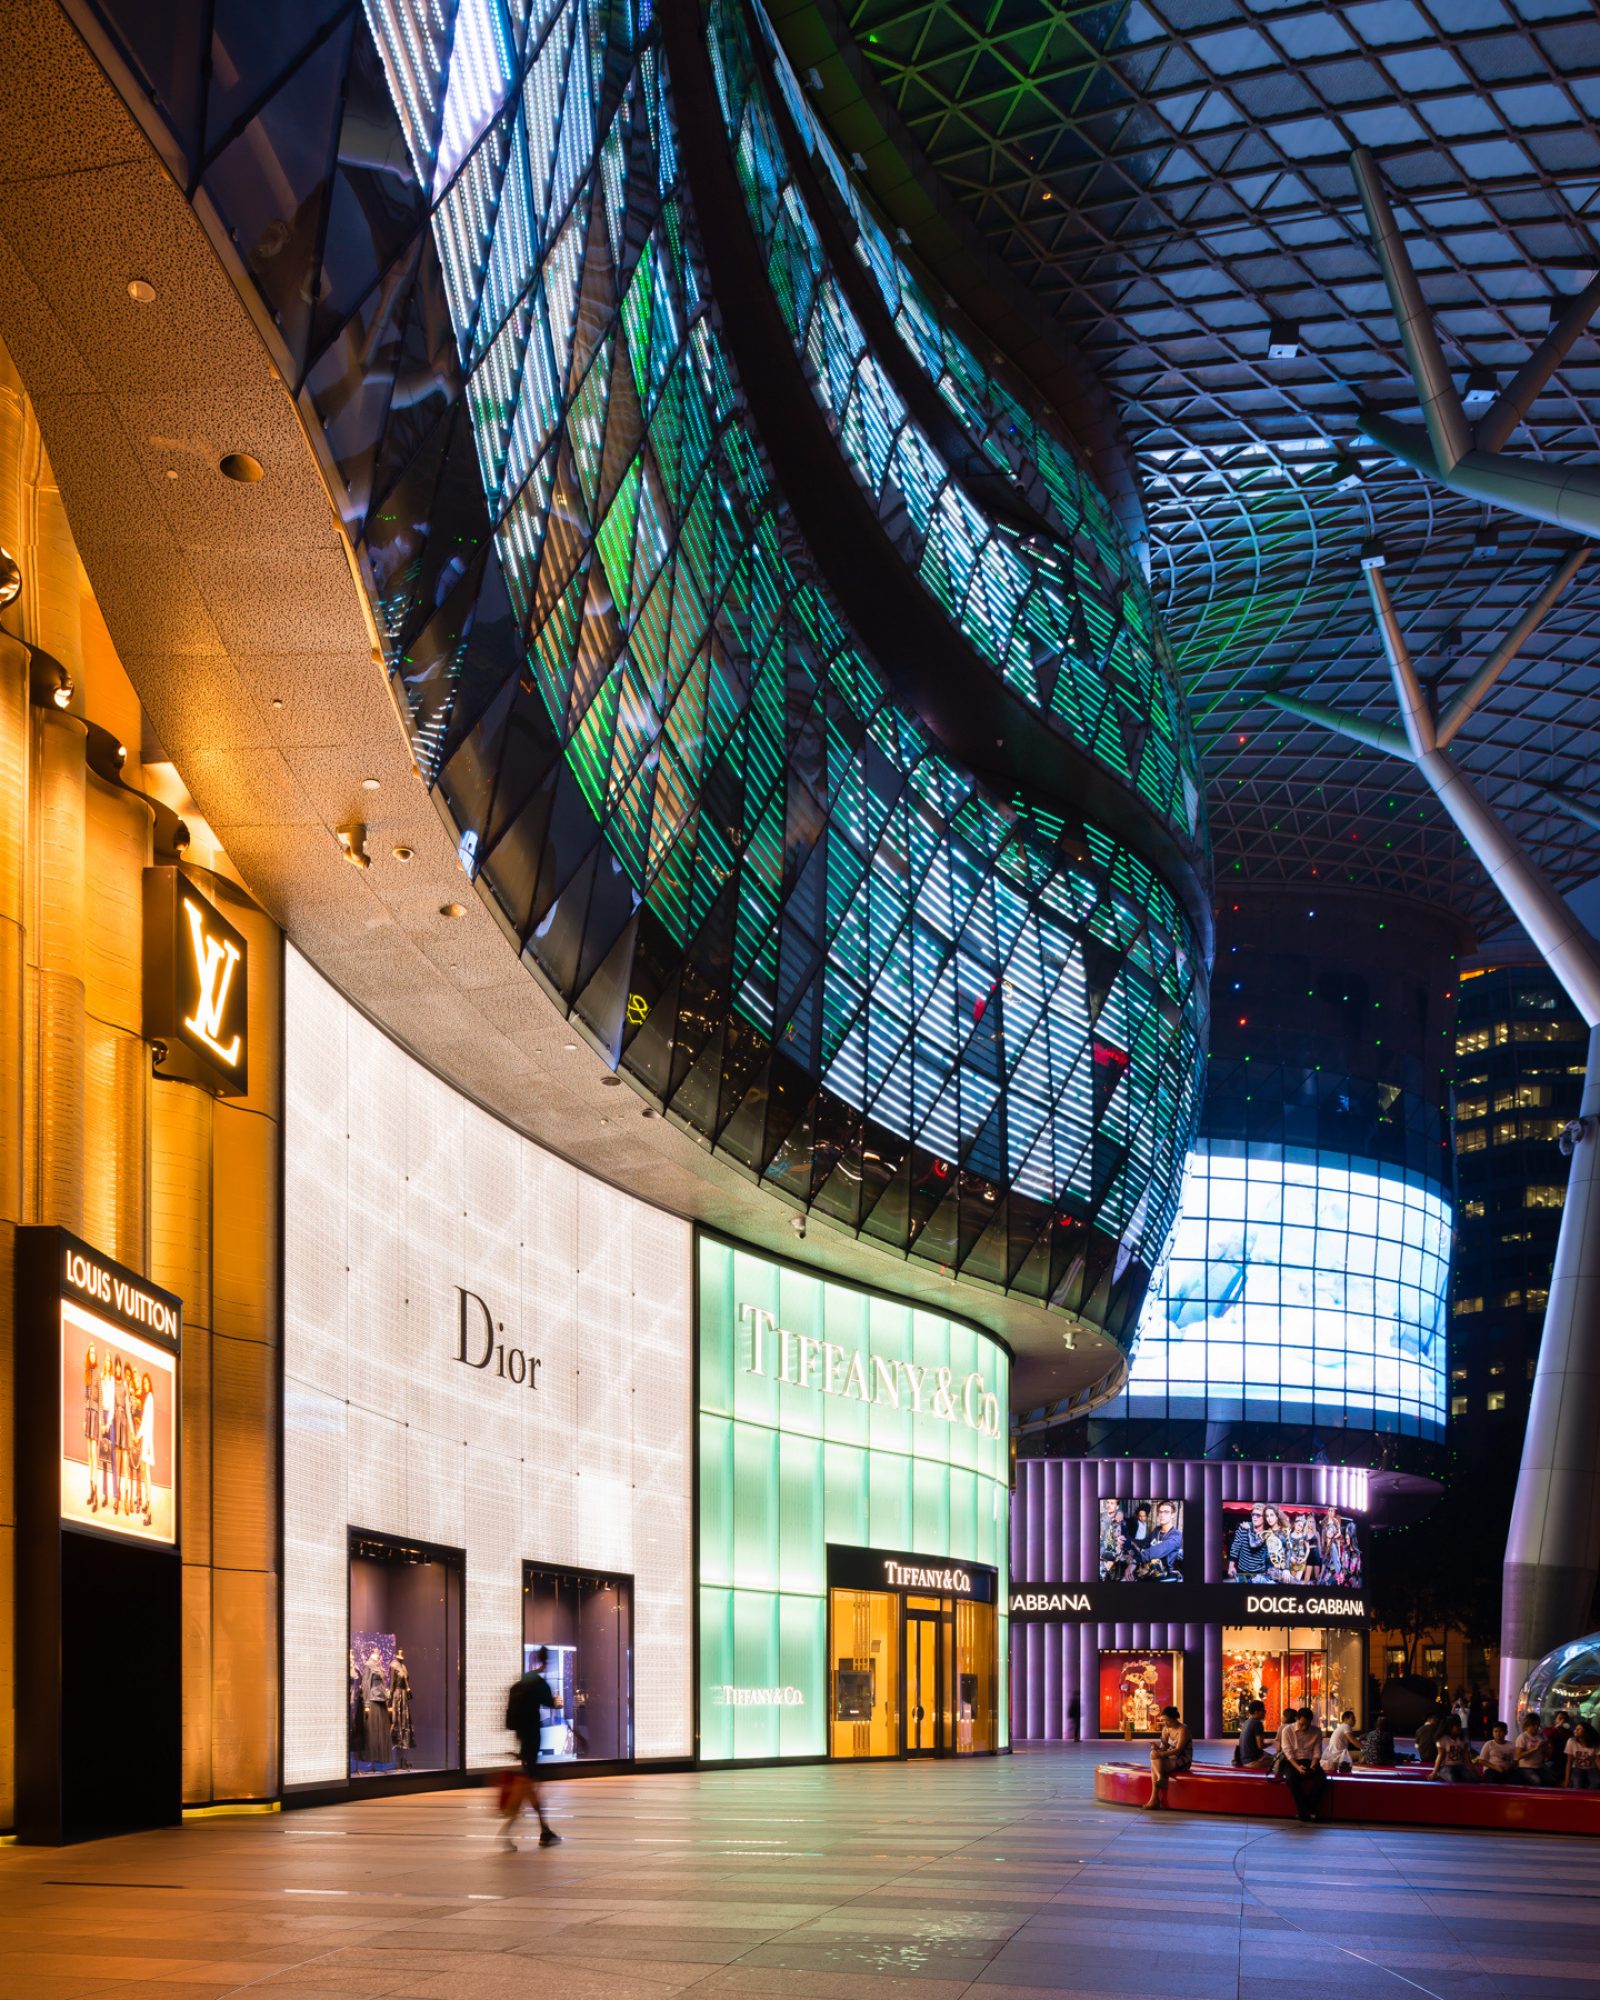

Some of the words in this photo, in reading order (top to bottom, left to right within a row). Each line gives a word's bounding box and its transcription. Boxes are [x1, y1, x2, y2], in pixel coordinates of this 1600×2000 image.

[66, 1249, 111, 1303] LOUIS
[113, 1278, 177, 1340] VUITTON
[453, 1285, 541, 1391] Dior
[1009, 1594, 1091, 1611] ABBANA
[1247, 1596, 1297, 1613] DOLCE
[1306, 1598, 1365, 1616] GABBANA
